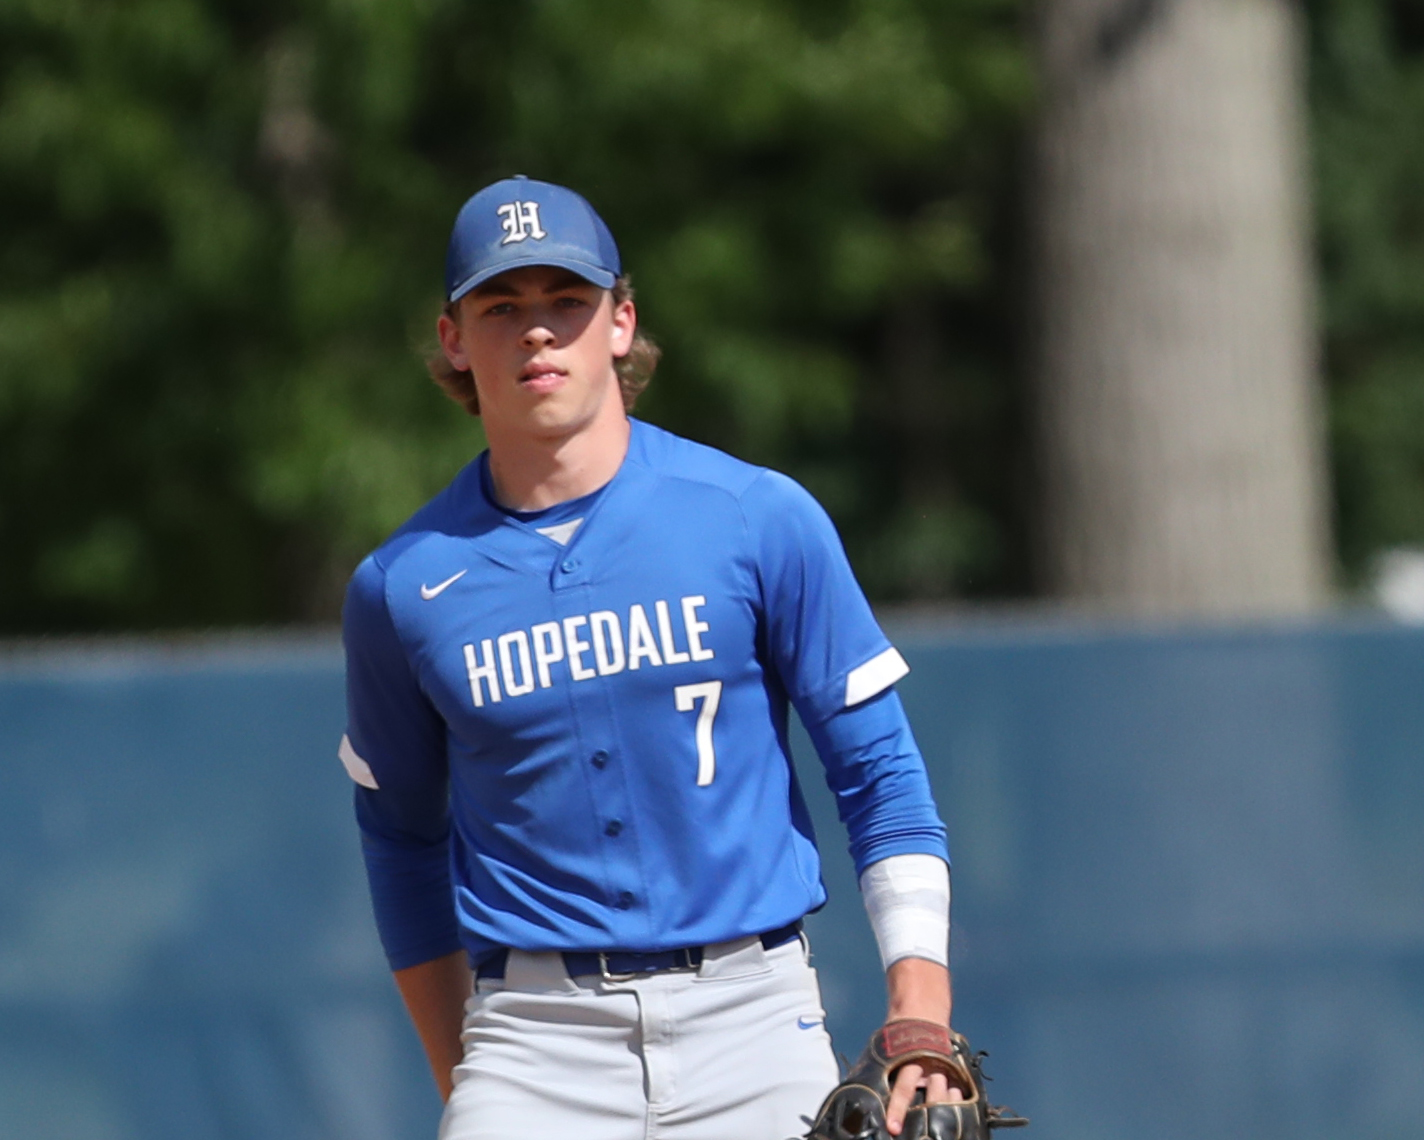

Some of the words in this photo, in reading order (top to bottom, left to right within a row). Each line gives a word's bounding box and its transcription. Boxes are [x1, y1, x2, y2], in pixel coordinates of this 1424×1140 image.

[497, 200, 546, 244] H
[463, 595, 714, 707] HOPEDALE
[674, 681, 722, 786] 7
